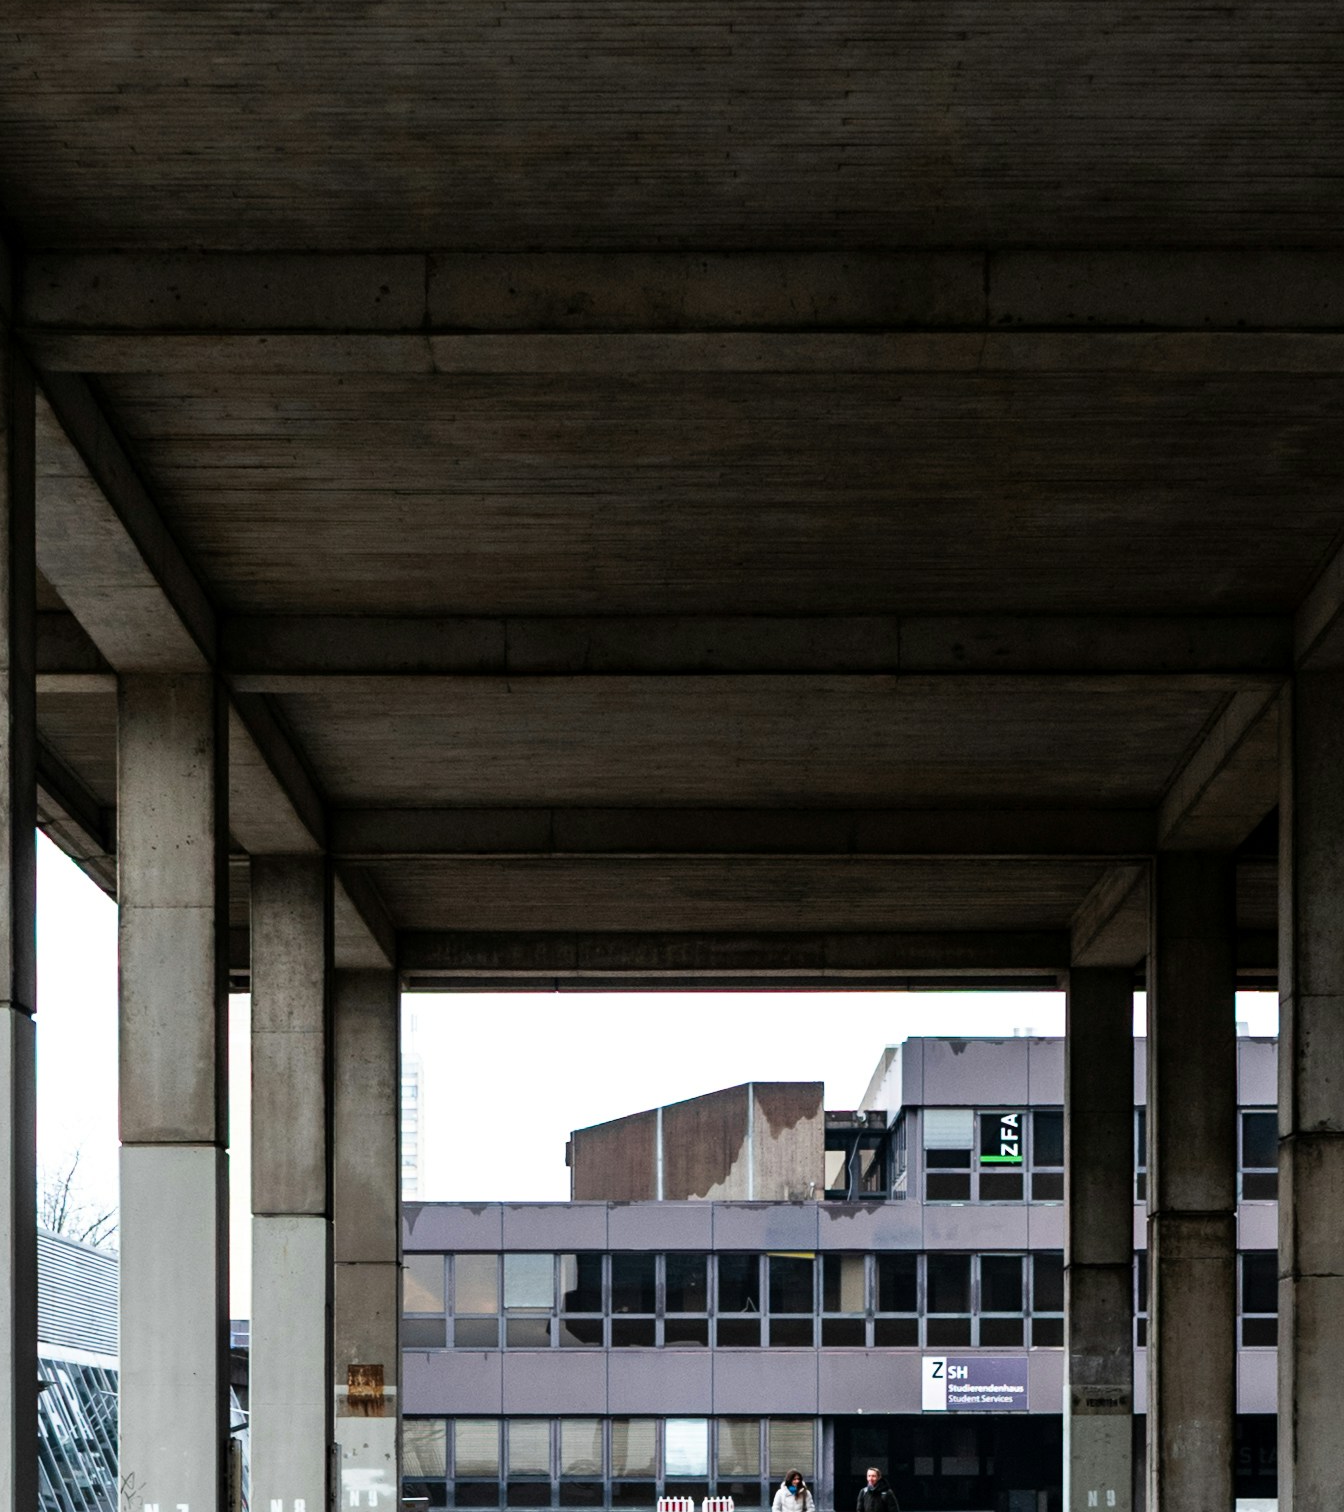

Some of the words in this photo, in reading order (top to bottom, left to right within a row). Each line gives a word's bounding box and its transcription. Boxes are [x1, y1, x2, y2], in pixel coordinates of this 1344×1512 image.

[1000, 1113, 1018, 1157] ZFA
[932, 1361, 944, 1379] Z
[947, 1365, 968, 1379] SH
[948, 1384, 1024, 1393] Studierendenhaus
[948, 1394, 980, 1403] Student
[981, 1394, 1013, 1403] Services
